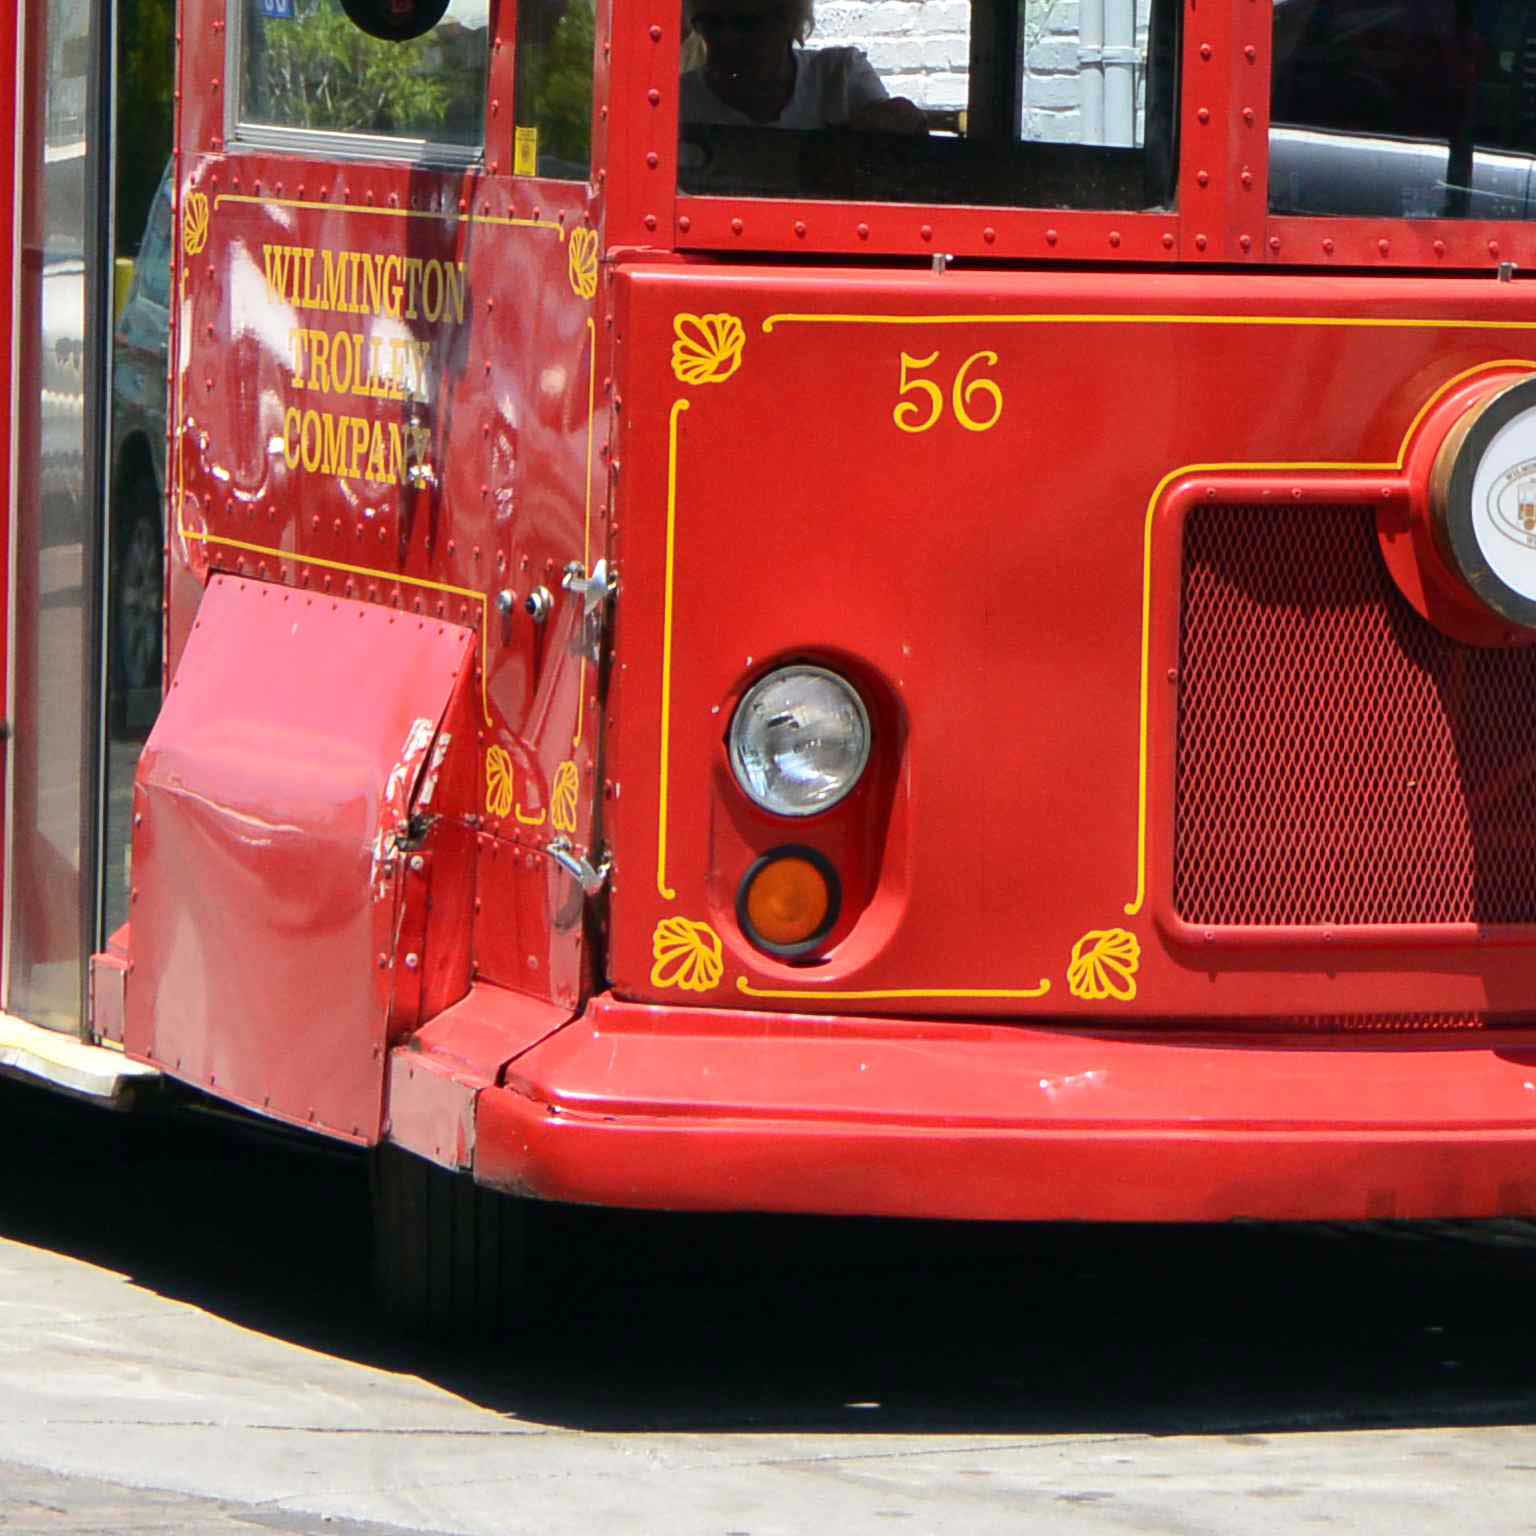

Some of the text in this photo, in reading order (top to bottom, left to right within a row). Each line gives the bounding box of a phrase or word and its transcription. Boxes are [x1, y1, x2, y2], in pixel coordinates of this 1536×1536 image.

[263, 244, 466, 324] WILMINGTON
[289, 328, 432, 404] TROLLEY
[893, 350, 1004, 433] 56
[283, 407, 432, 491] COMPANY
